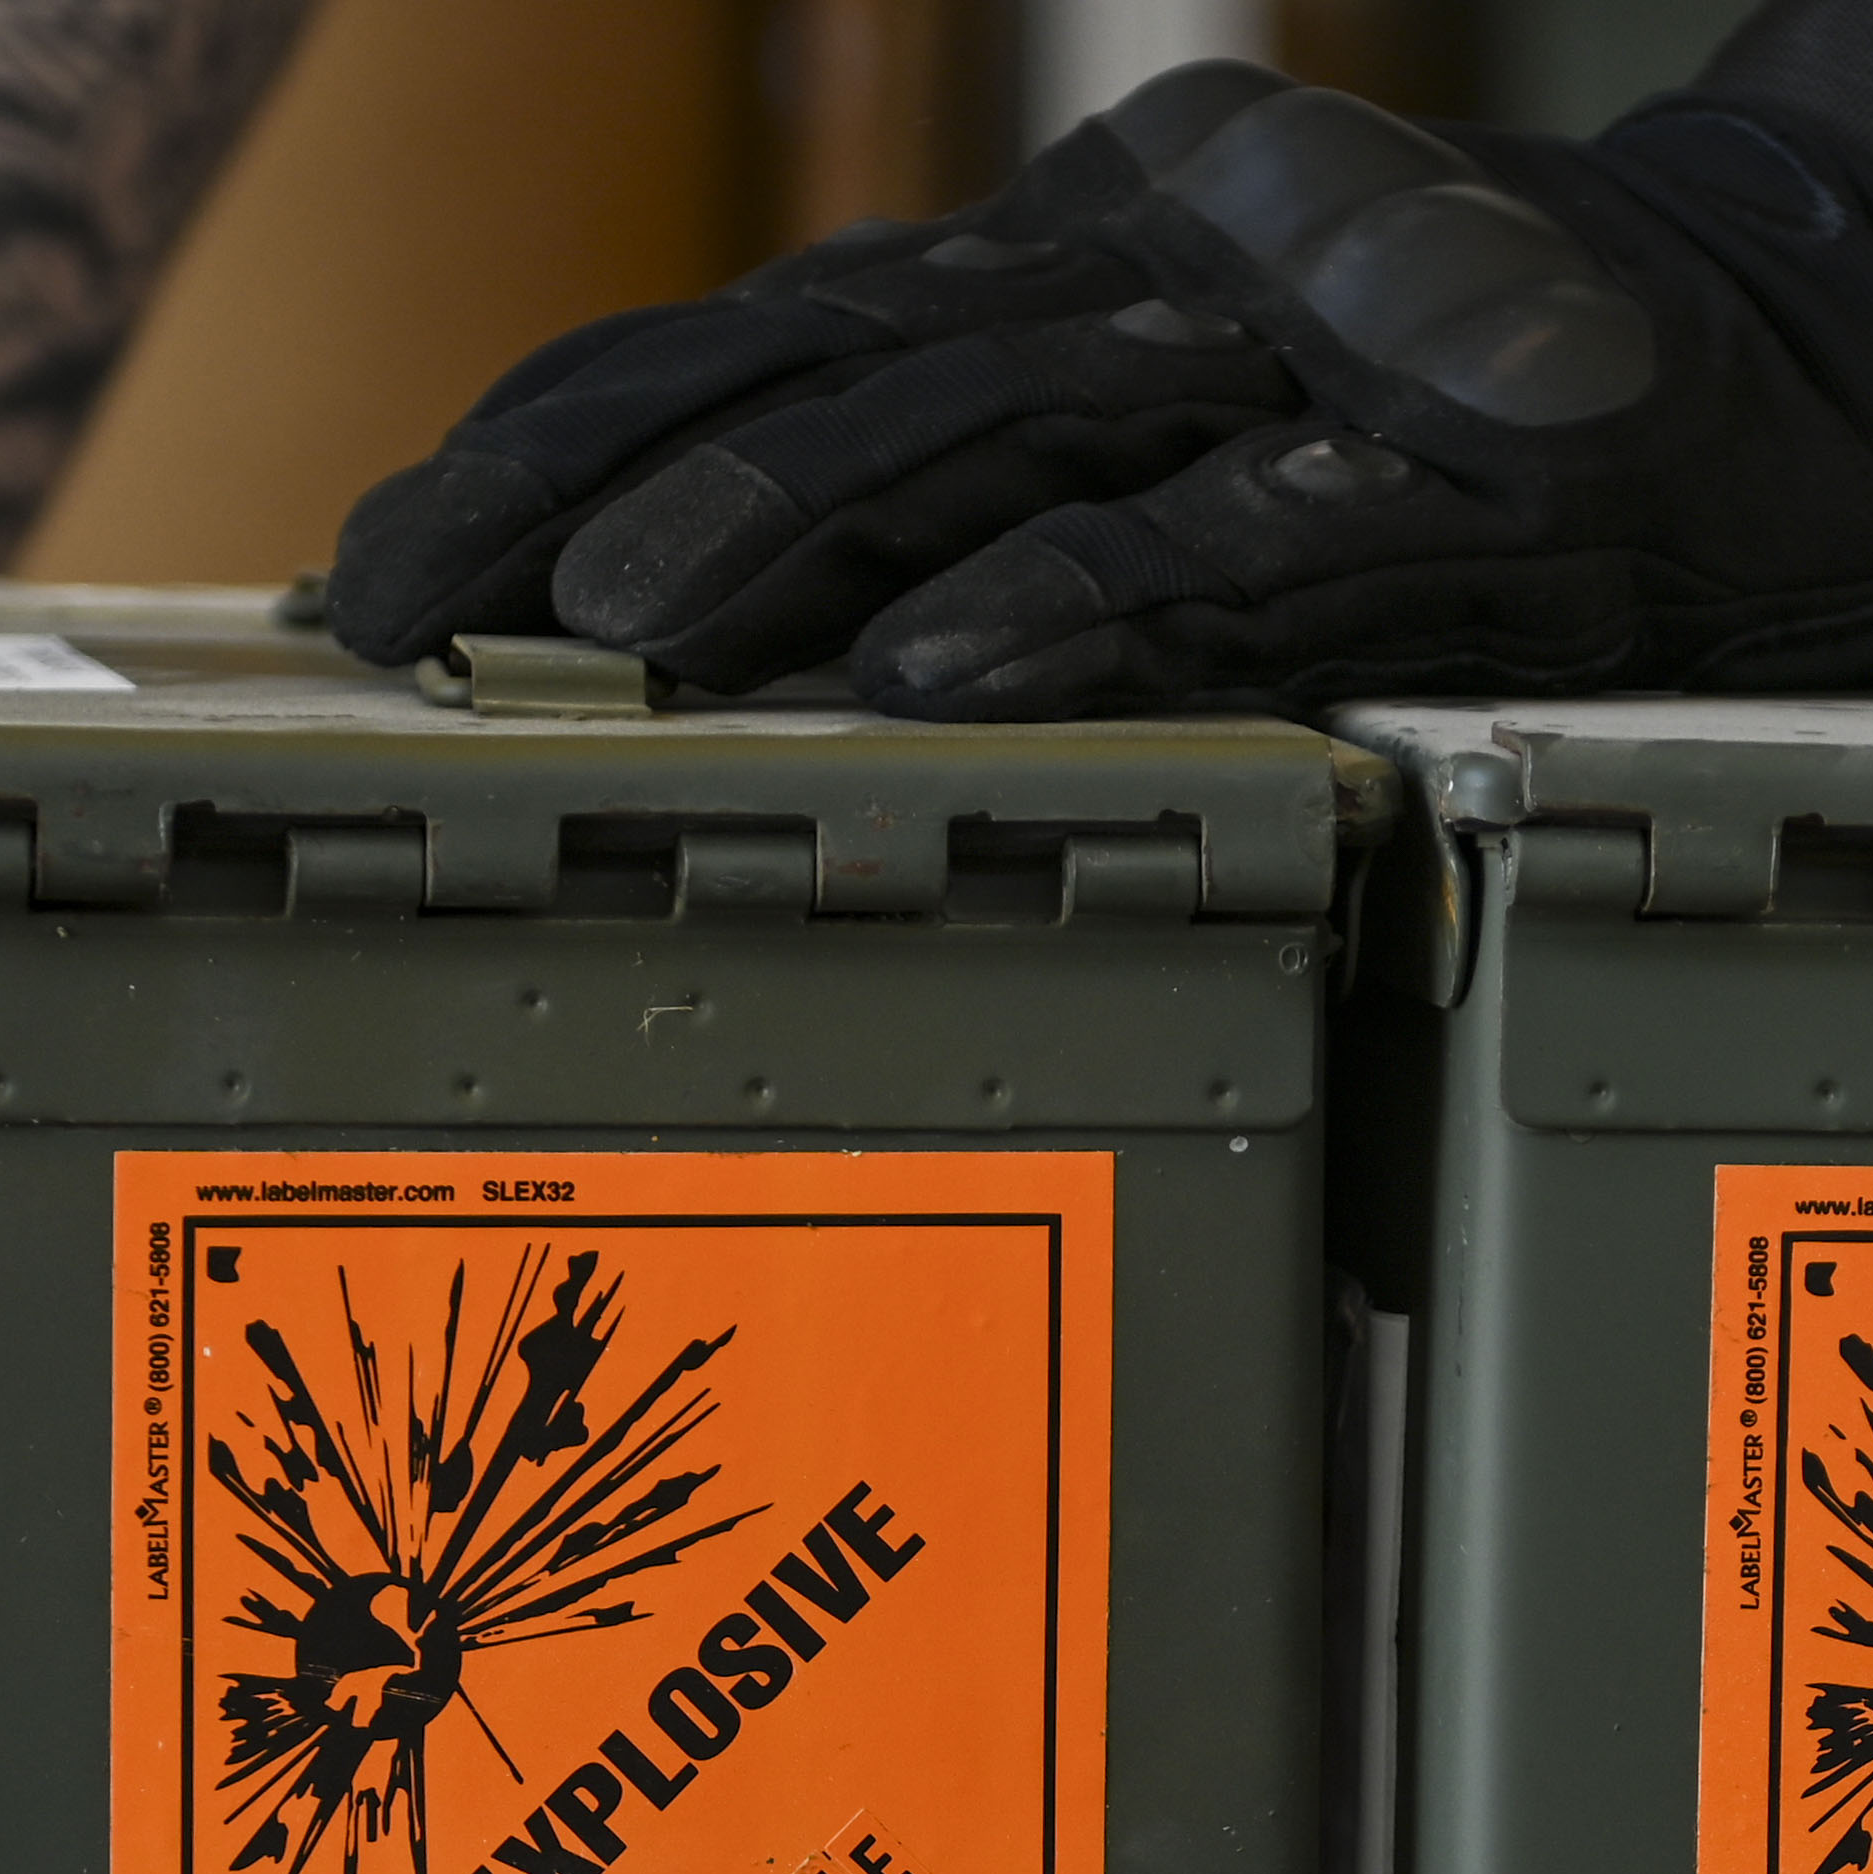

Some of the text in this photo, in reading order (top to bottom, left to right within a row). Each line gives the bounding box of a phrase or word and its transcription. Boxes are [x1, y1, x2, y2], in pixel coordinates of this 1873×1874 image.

[195, 1180, 576, 1203] www.labelmaster.com SLEX32
[149, 1221, 171, 1328] 621-5808
[1745, 1236, 1769, 1341] 621-5808
[148, 1333, 175, 1392] (800)
[1745, 1346, 1769, 1405] (800)
